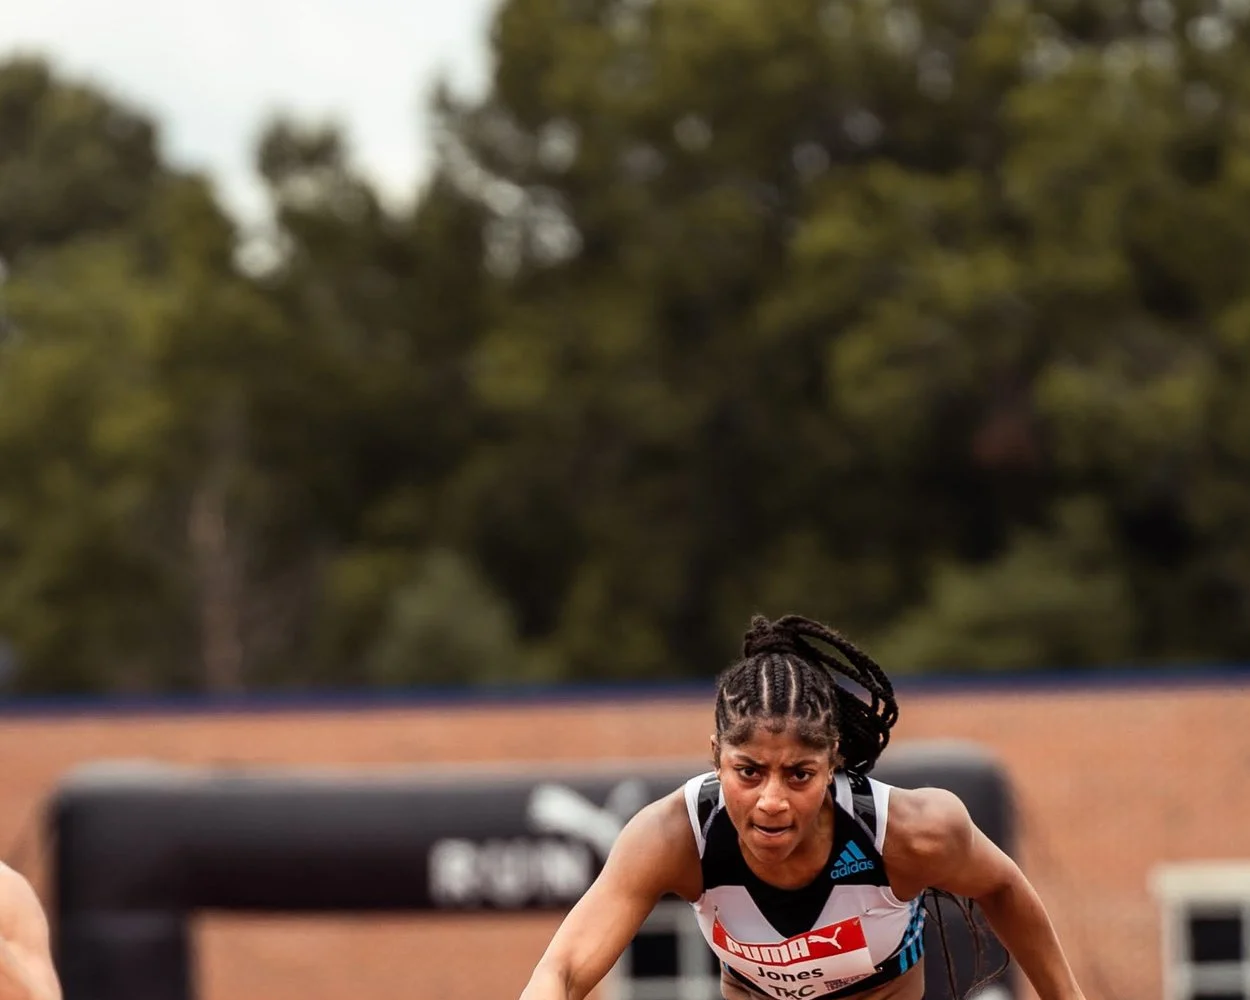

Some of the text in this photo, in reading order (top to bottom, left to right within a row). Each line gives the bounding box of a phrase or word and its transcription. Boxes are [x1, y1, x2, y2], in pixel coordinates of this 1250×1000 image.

[430, 837, 592, 906] RUN
[830, 860, 874, 879] adidas
[725, 935, 810, 963] PUMA
[757, 966, 824, 982] Jones
[768, 984, 816, 1000] TKC
